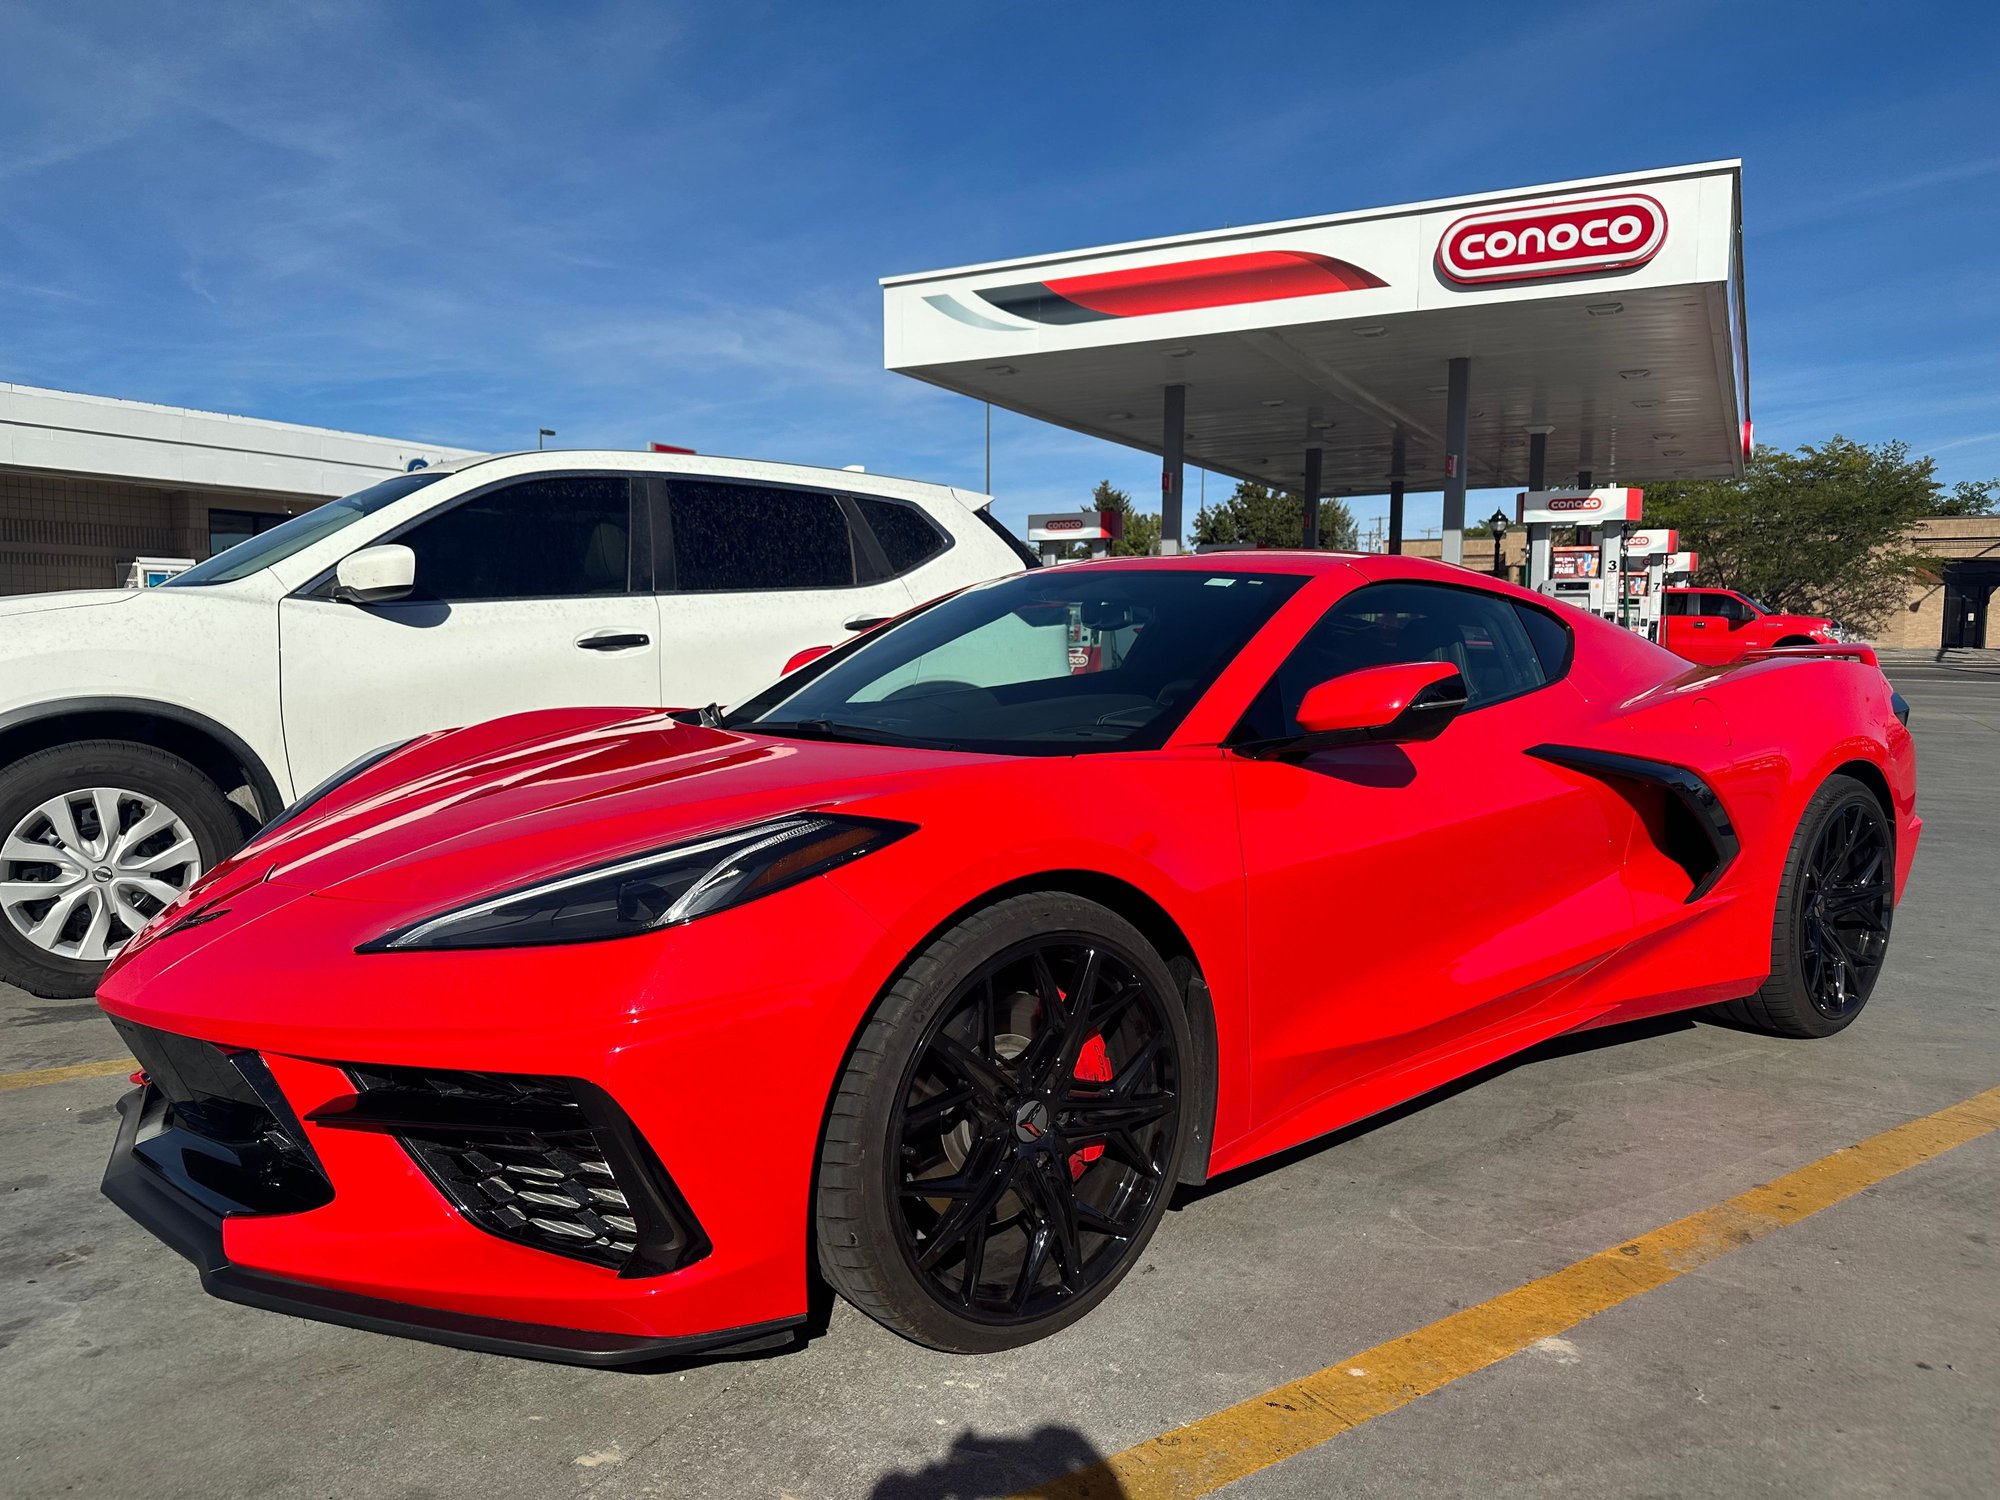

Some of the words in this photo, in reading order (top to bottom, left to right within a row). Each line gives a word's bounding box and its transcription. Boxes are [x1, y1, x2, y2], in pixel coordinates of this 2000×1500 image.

[1459, 215, 1643, 261] conoco
[1551, 500, 1600, 509] conoco
[1047, 521, 1082, 529] conoco
[1629, 537, 1648, 545] oco
[1607, 560, 1617, 571] 3
[1653, 582, 1661, 591] 7
[1069, 656, 1086, 664] oco
